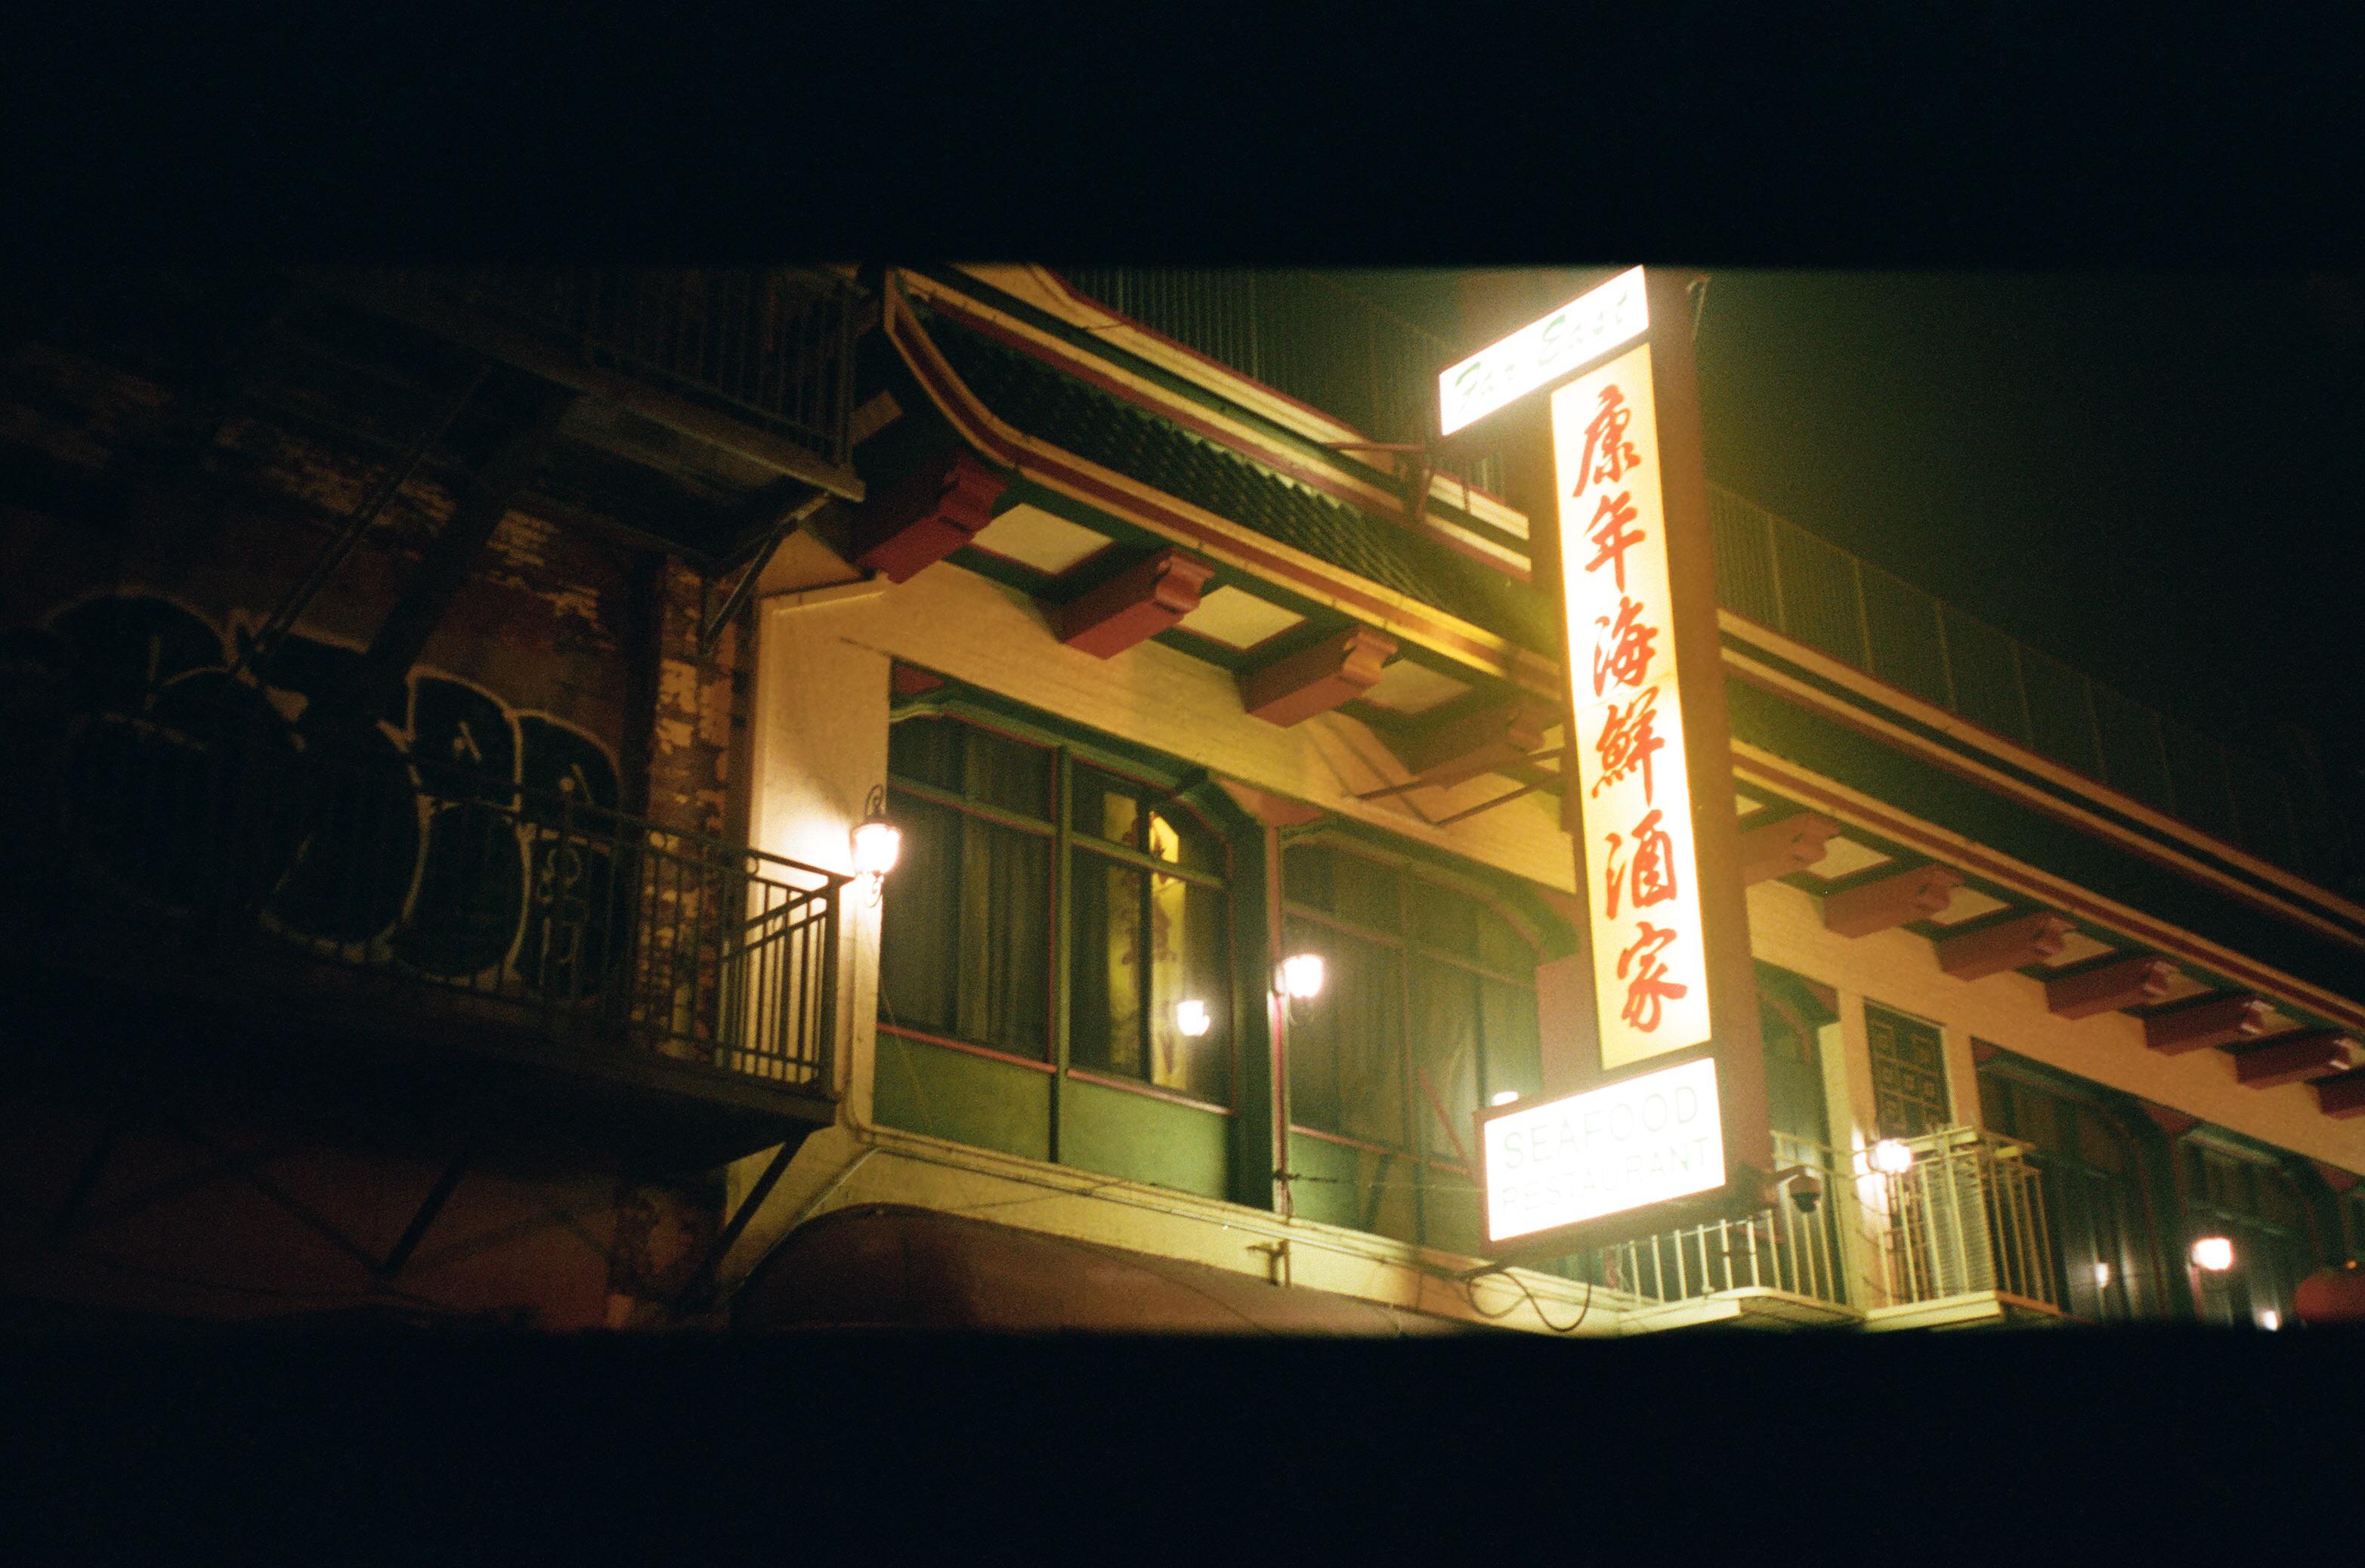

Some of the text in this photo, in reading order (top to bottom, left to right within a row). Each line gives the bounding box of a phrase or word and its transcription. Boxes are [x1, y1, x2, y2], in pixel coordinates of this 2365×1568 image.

[1573, 384, 1688, 1034] 康年海鮮酒家
[1502, 1084, 1699, 1170] SEAFOOD
[1500, 1136, 1709, 1216] RESTAURANT
